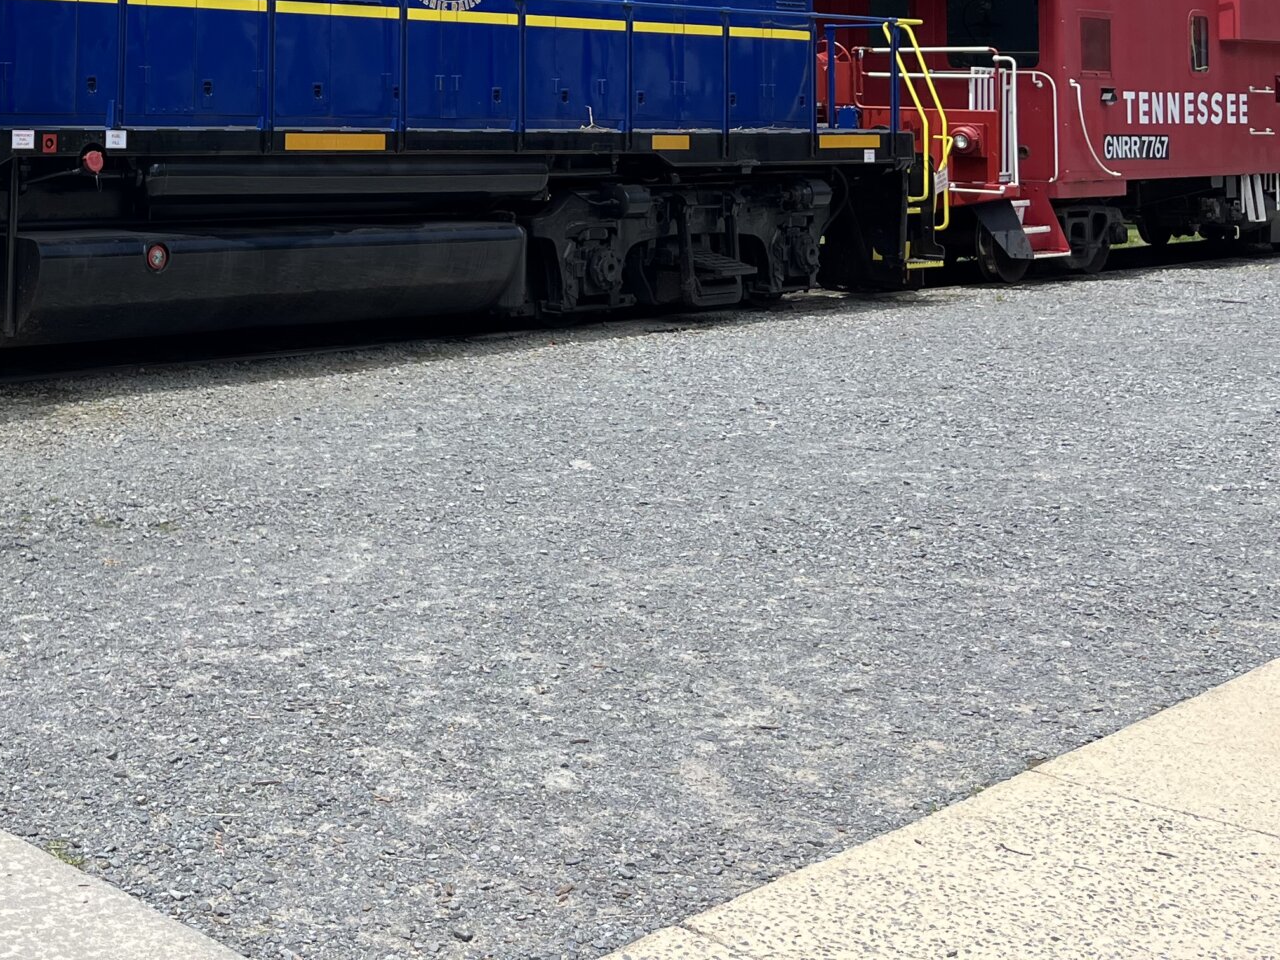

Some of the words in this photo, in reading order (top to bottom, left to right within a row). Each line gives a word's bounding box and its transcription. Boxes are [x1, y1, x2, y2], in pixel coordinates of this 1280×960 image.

[1122, 91, 1248, 125] TENNESSEE
[1104, 135, 1140, 159] GNRR
[1141, 136, 1169, 158] 7767
